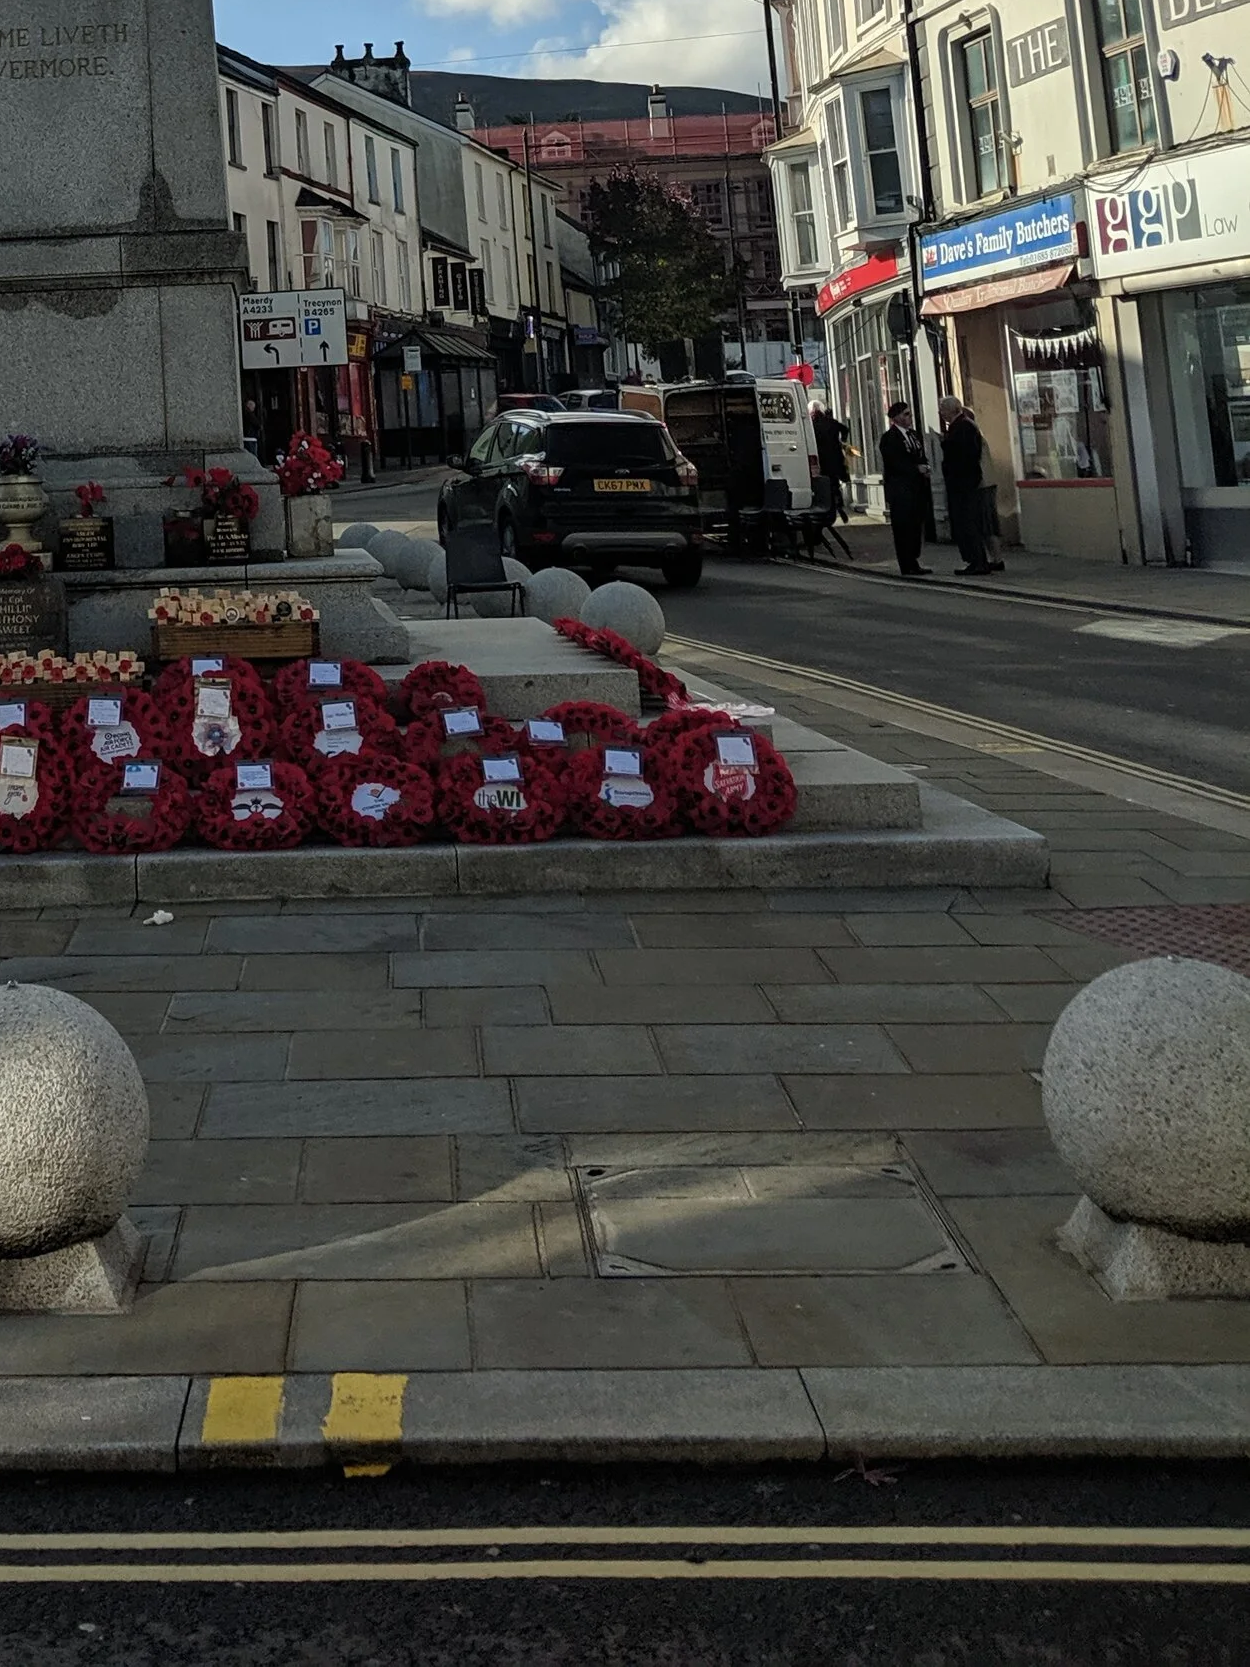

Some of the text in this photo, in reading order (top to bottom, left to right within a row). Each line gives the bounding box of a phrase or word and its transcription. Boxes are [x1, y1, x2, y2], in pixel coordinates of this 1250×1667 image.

[40, 24, 128, 46] LIVETH
[1011, 24, 1062, 79] THE
[1204, 214, 1238, 237] Law
[940, 213, 1070, 265] Dave's Family Butchers
[242, 297, 273, 307] Maerdy
[303, 299, 342, 308] Trecynon
[598, 481, 624, 490] CK67
